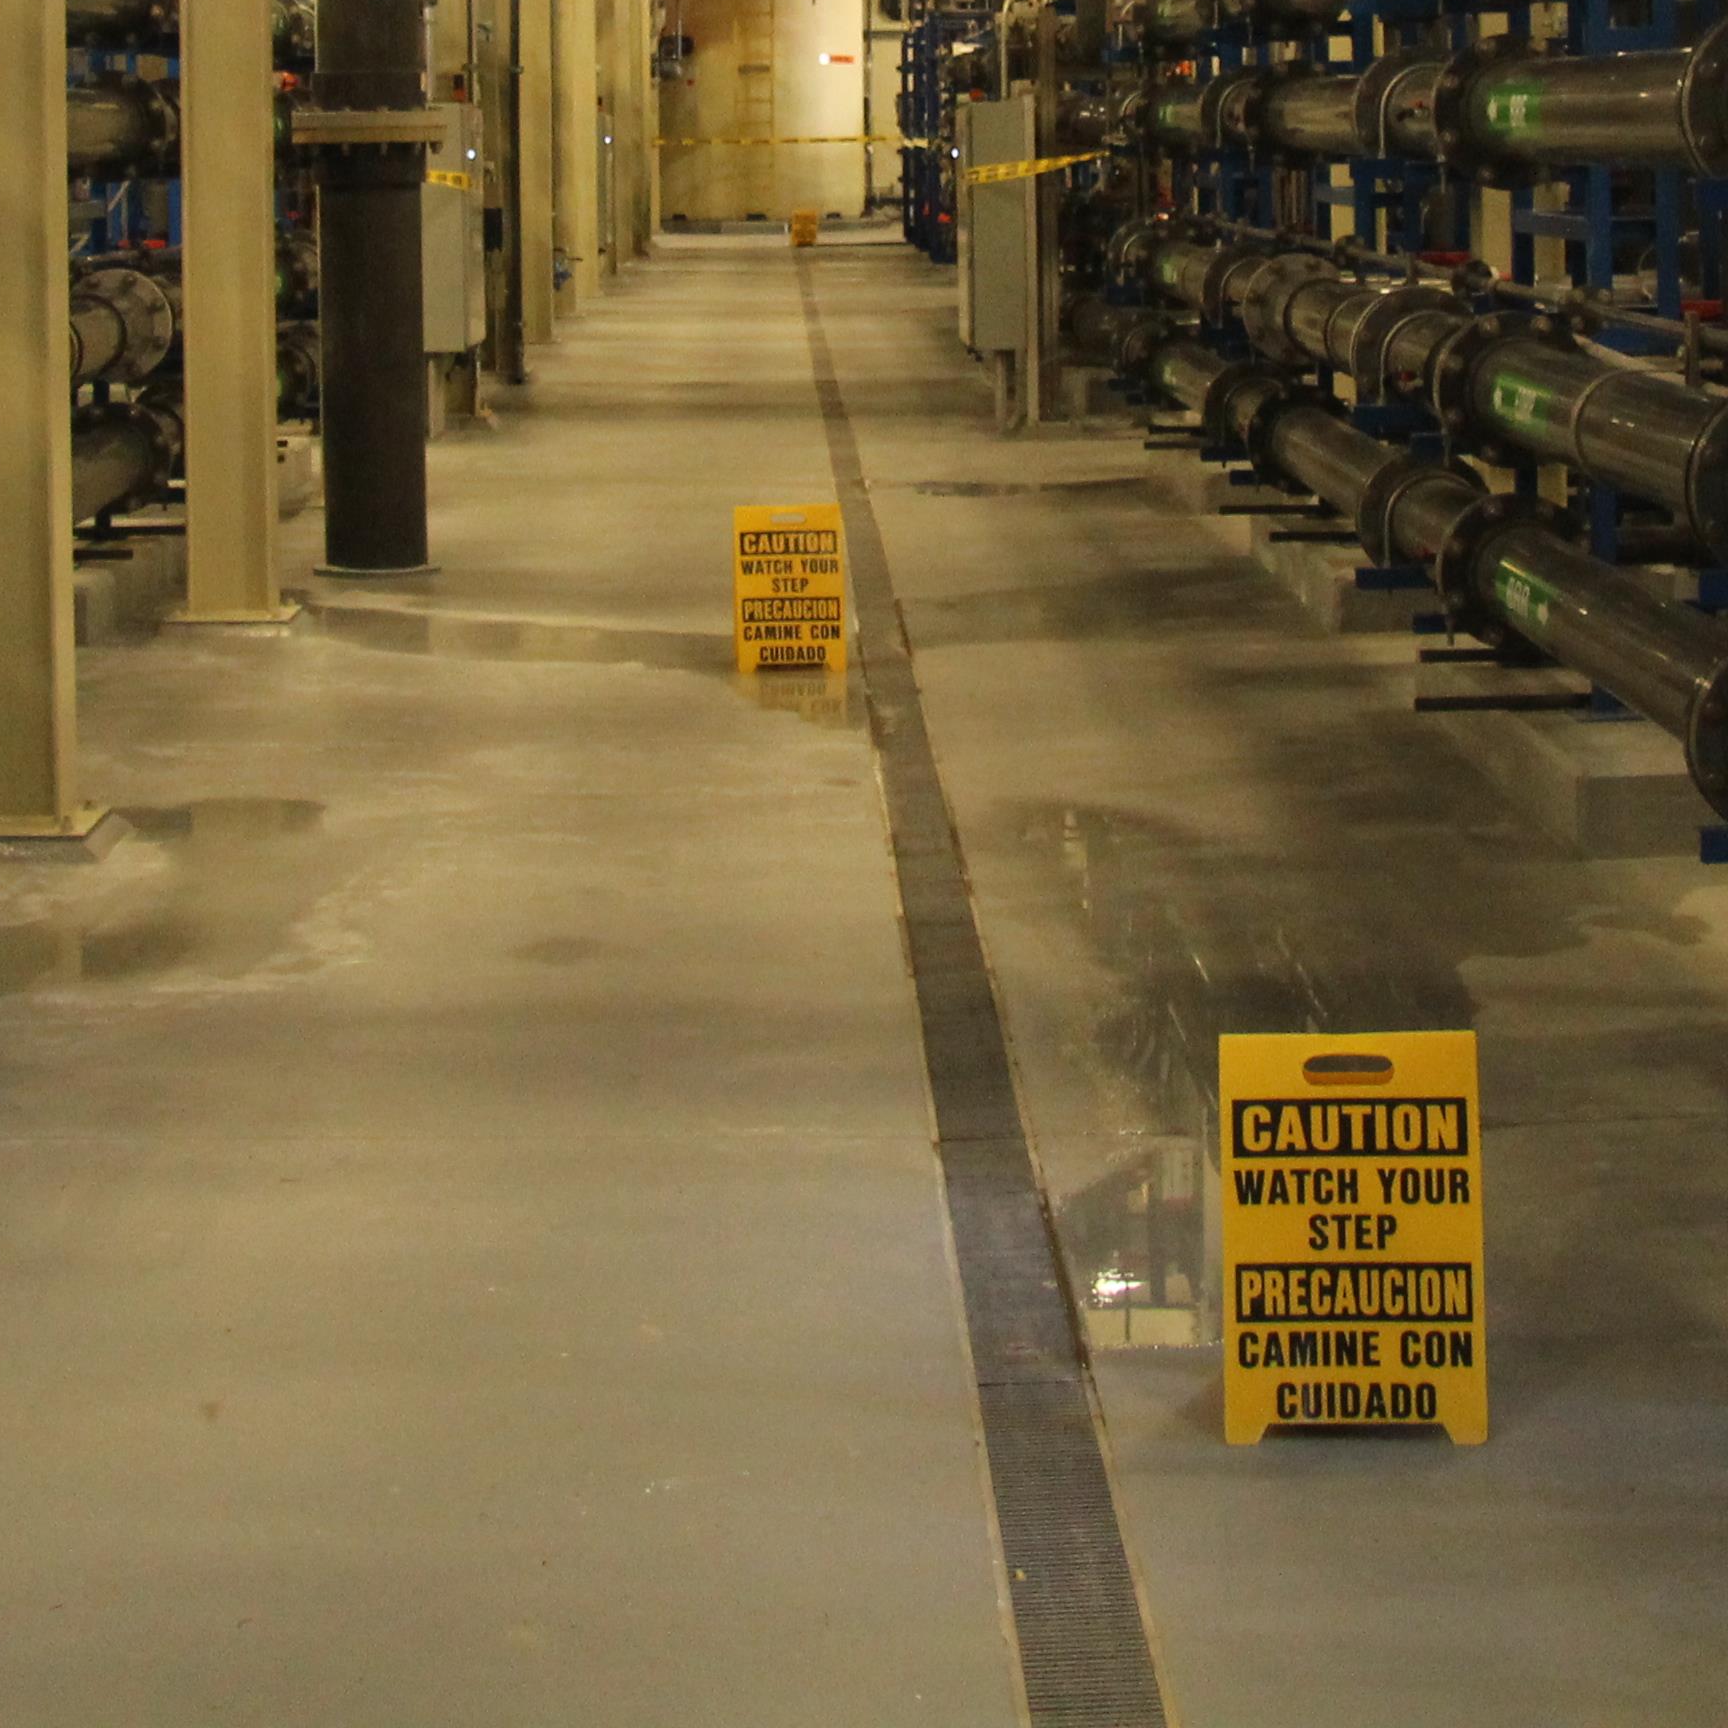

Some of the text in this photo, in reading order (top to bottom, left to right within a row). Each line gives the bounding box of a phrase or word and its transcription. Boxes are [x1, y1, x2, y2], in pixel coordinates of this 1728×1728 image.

[743, 533, 834, 554] CAUTION
[741, 559, 839, 575] WATCH YOUR
[772, 578, 809, 593] STEP
[744, 600, 838, 620] PRECAUCION
[743, 625, 841, 641] CAMINE CON
[759, 646, 826, 662] CUIDADO
[1242, 1104, 1459, 1152] CAUTION
[1234, 1168, 1470, 1205] WATCH YOUR
[1309, 1215, 1397, 1250] STEP
[1242, 1270, 1467, 1317] PRECAUCION
[1238, 1331, 1473, 1367] CAMINE CON
[1277, 1382, 1437, 1420] CUIDADO
